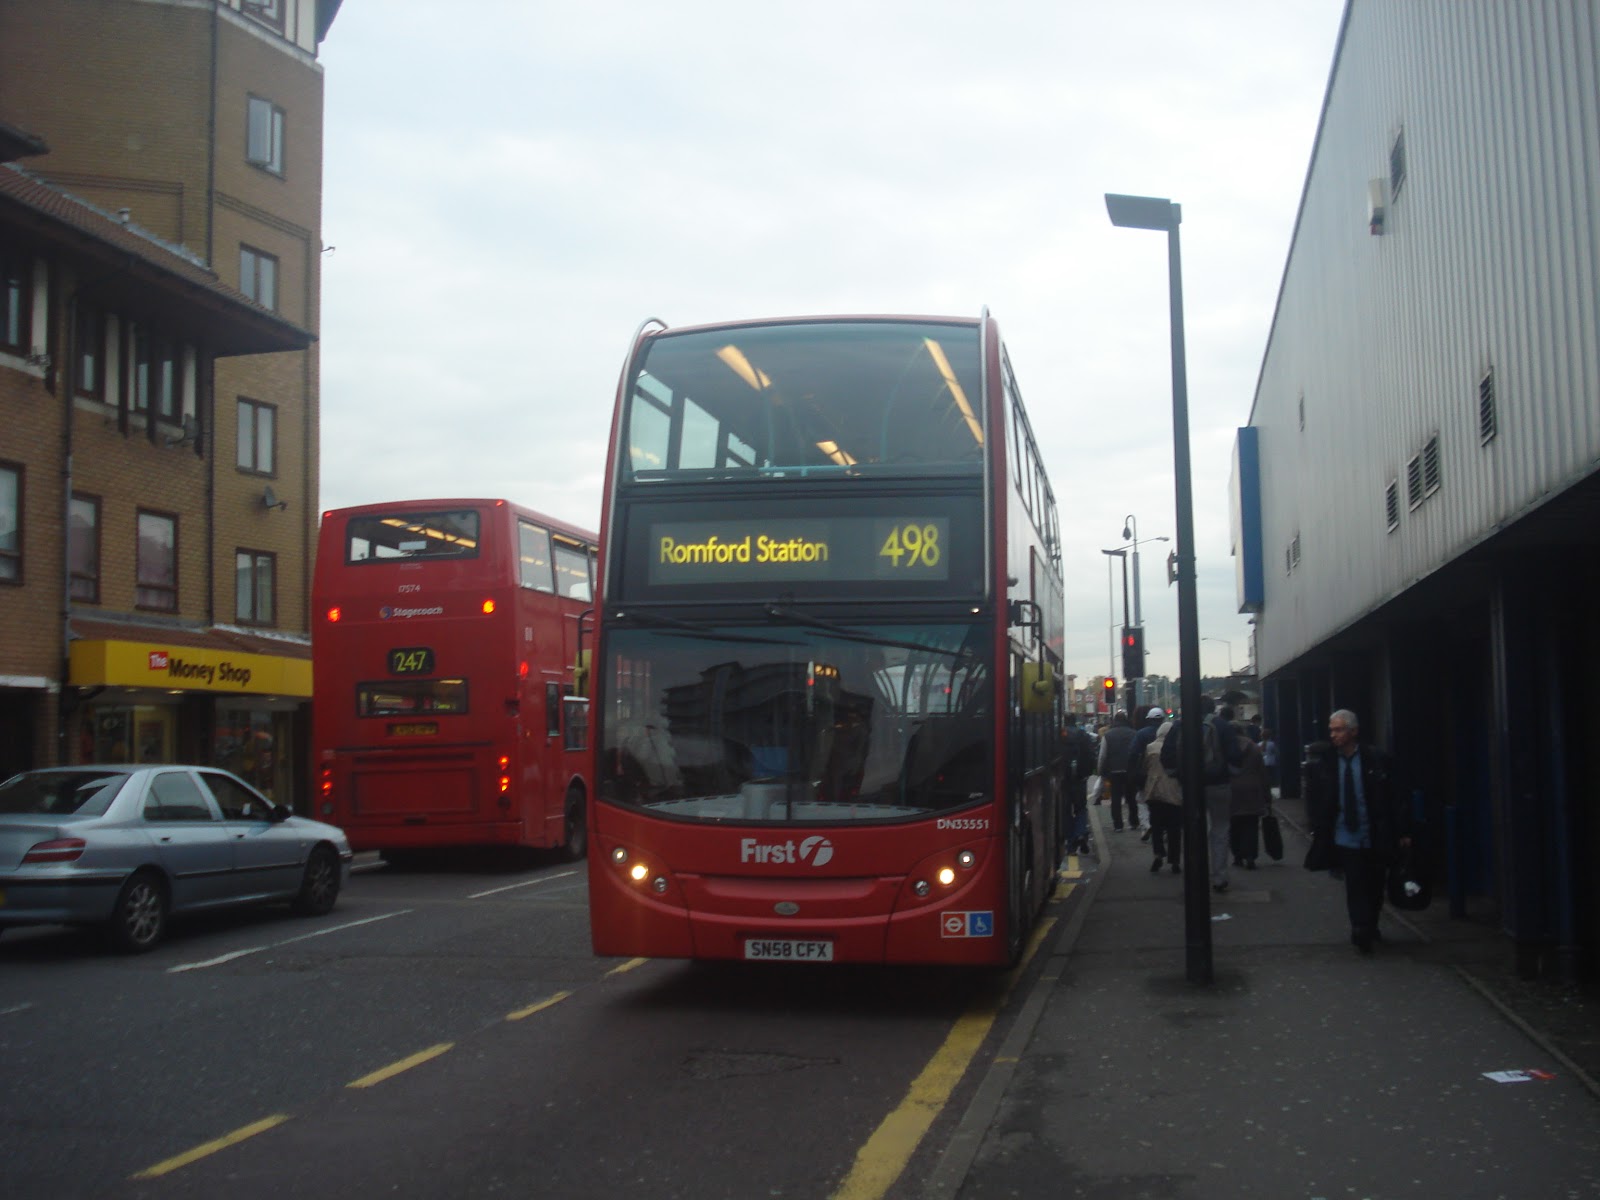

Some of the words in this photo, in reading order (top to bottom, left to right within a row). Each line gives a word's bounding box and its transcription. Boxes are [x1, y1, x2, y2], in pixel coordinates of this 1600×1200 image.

[660, 535, 751, 564] Romford
[756, 535, 828, 563] Station
[879, 523, 941, 568] 498
[393, 606, 443, 618] Stagecoach
[150, 653, 167, 668] The
[395, 651, 427, 671] 247
[169, 659, 215, 684] Money
[219, 662, 251, 687] Shop
[936, 818, 990, 830] DN33551
[741, 838, 796, 863] First
[751, 941, 792, 957] SN58
[796, 942, 827, 958] CFX
